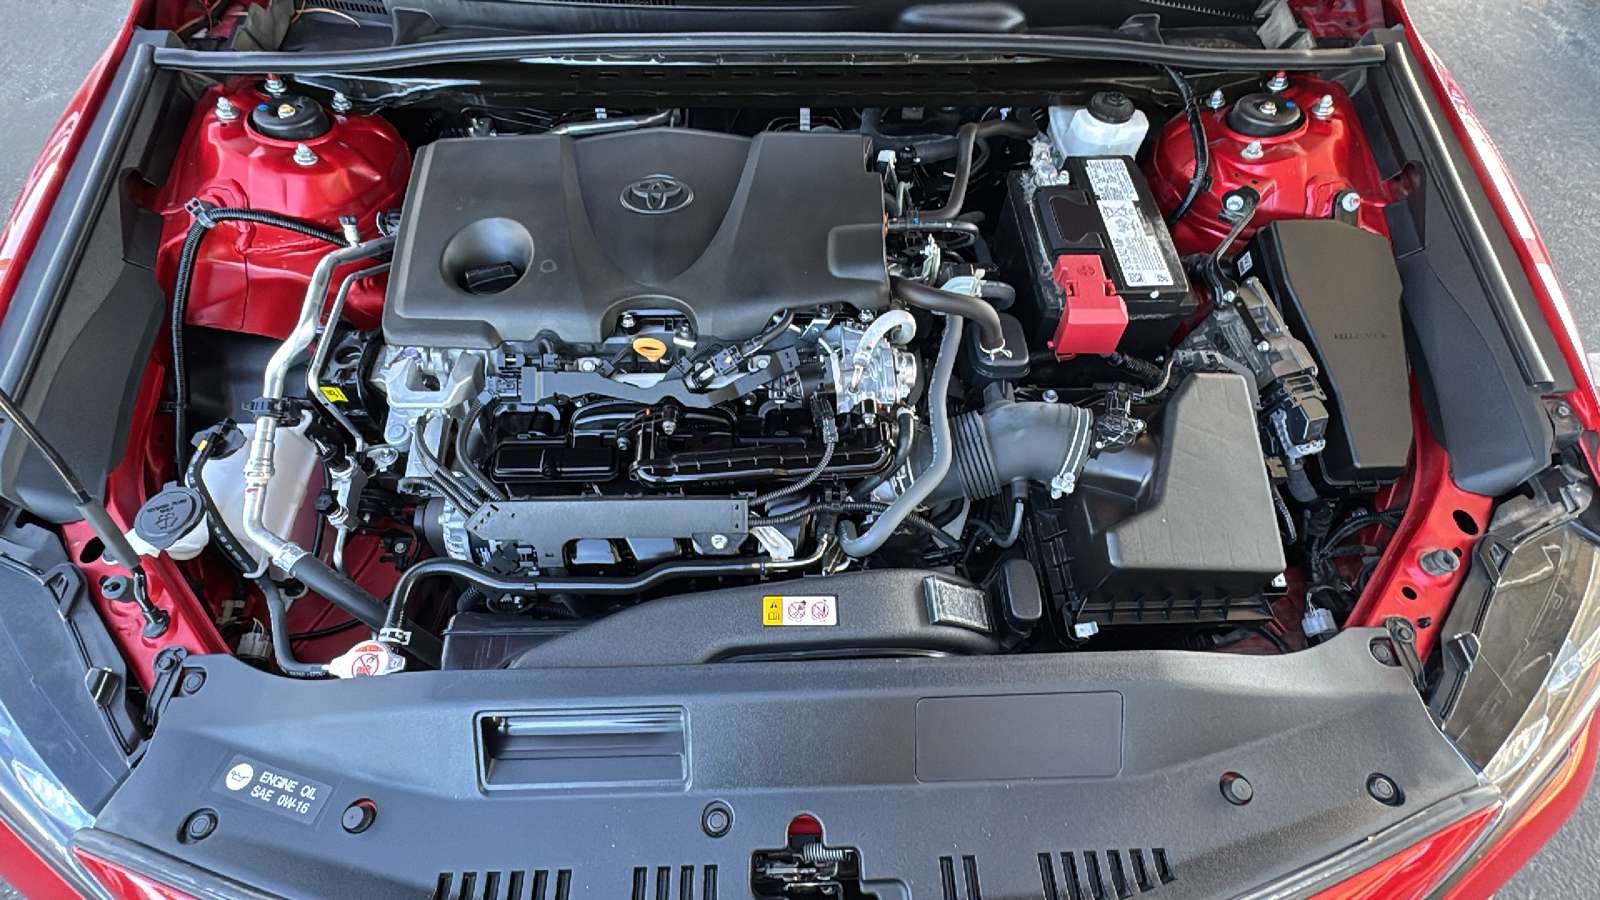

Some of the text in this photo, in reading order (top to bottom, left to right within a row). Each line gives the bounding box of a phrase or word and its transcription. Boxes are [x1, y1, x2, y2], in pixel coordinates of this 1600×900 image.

[250, 784, 310, 814] SAE 0W-16
[259, 771, 317, 801] ENGINE OIL
